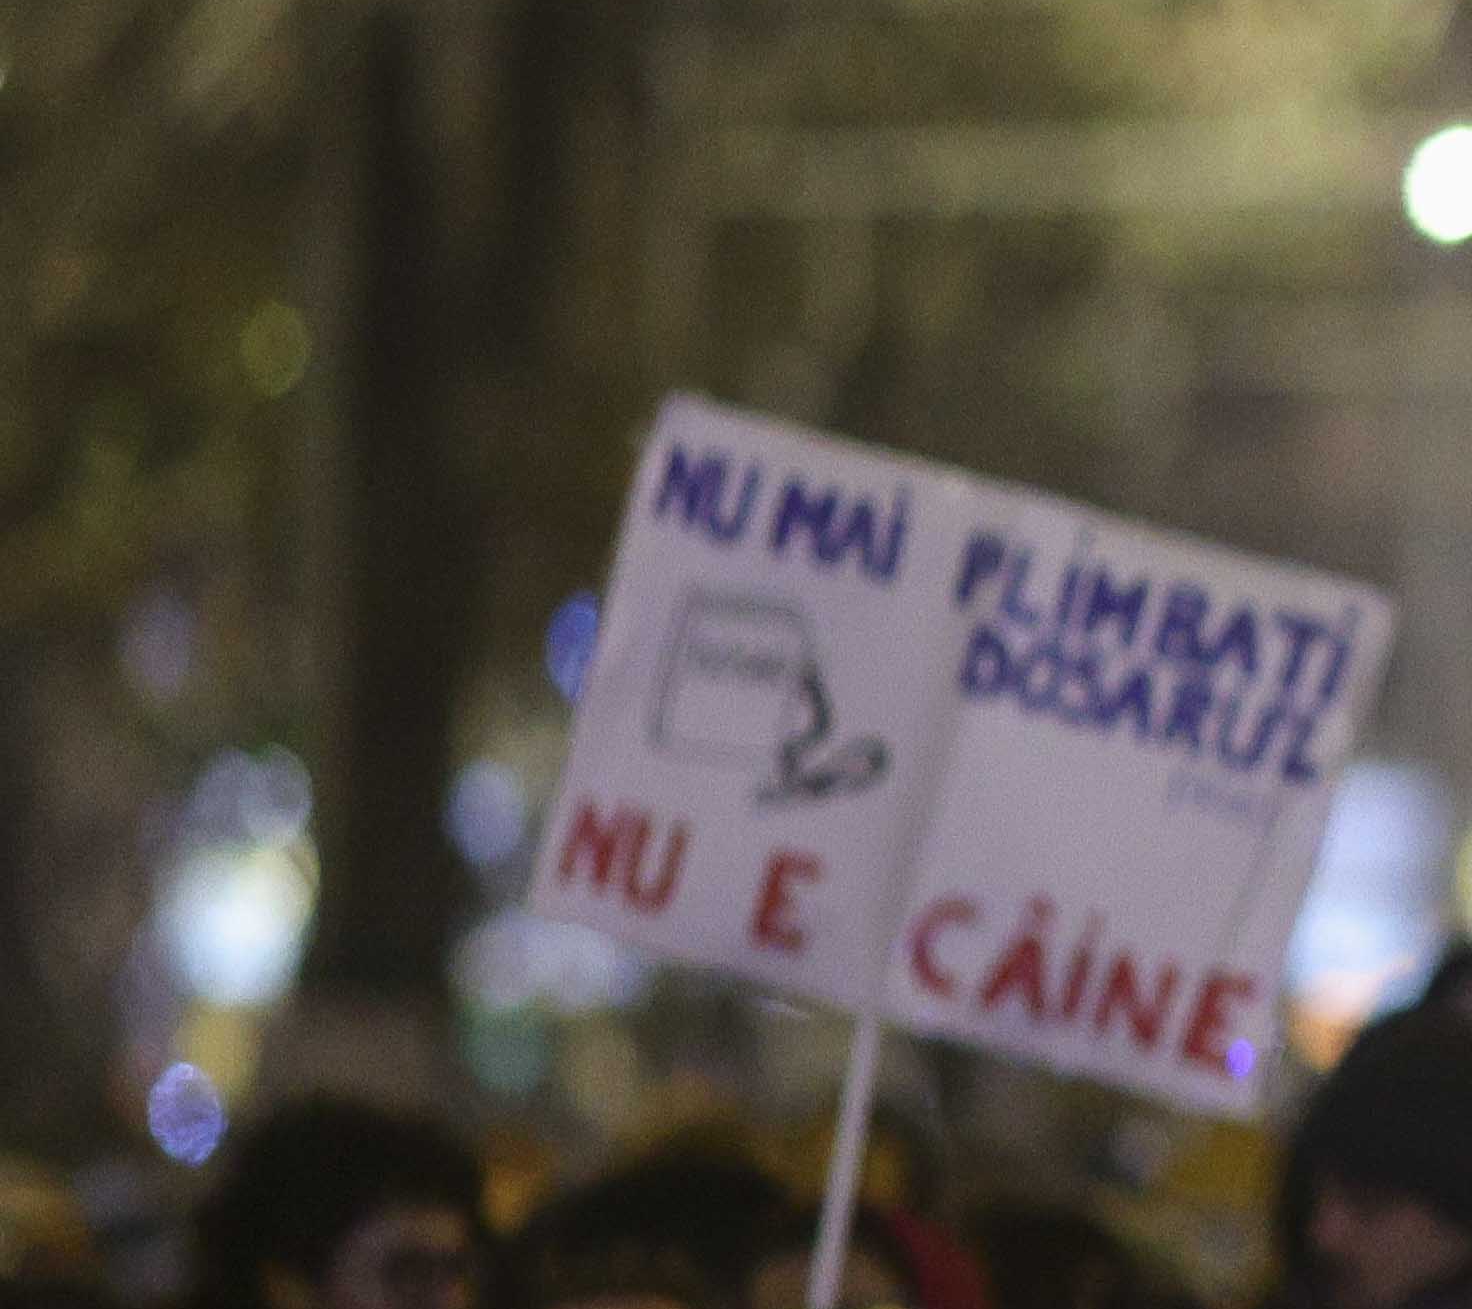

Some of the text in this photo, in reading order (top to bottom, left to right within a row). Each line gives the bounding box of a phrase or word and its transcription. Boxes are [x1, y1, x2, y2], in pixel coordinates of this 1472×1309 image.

[657, 443, 763, 542] NU
[771, 475, 912, 582] MAI
[960, 624, 1322, 785] DOSARUL
[557, 796, 686, 914] NU
[751, 847, 820, 949] E
